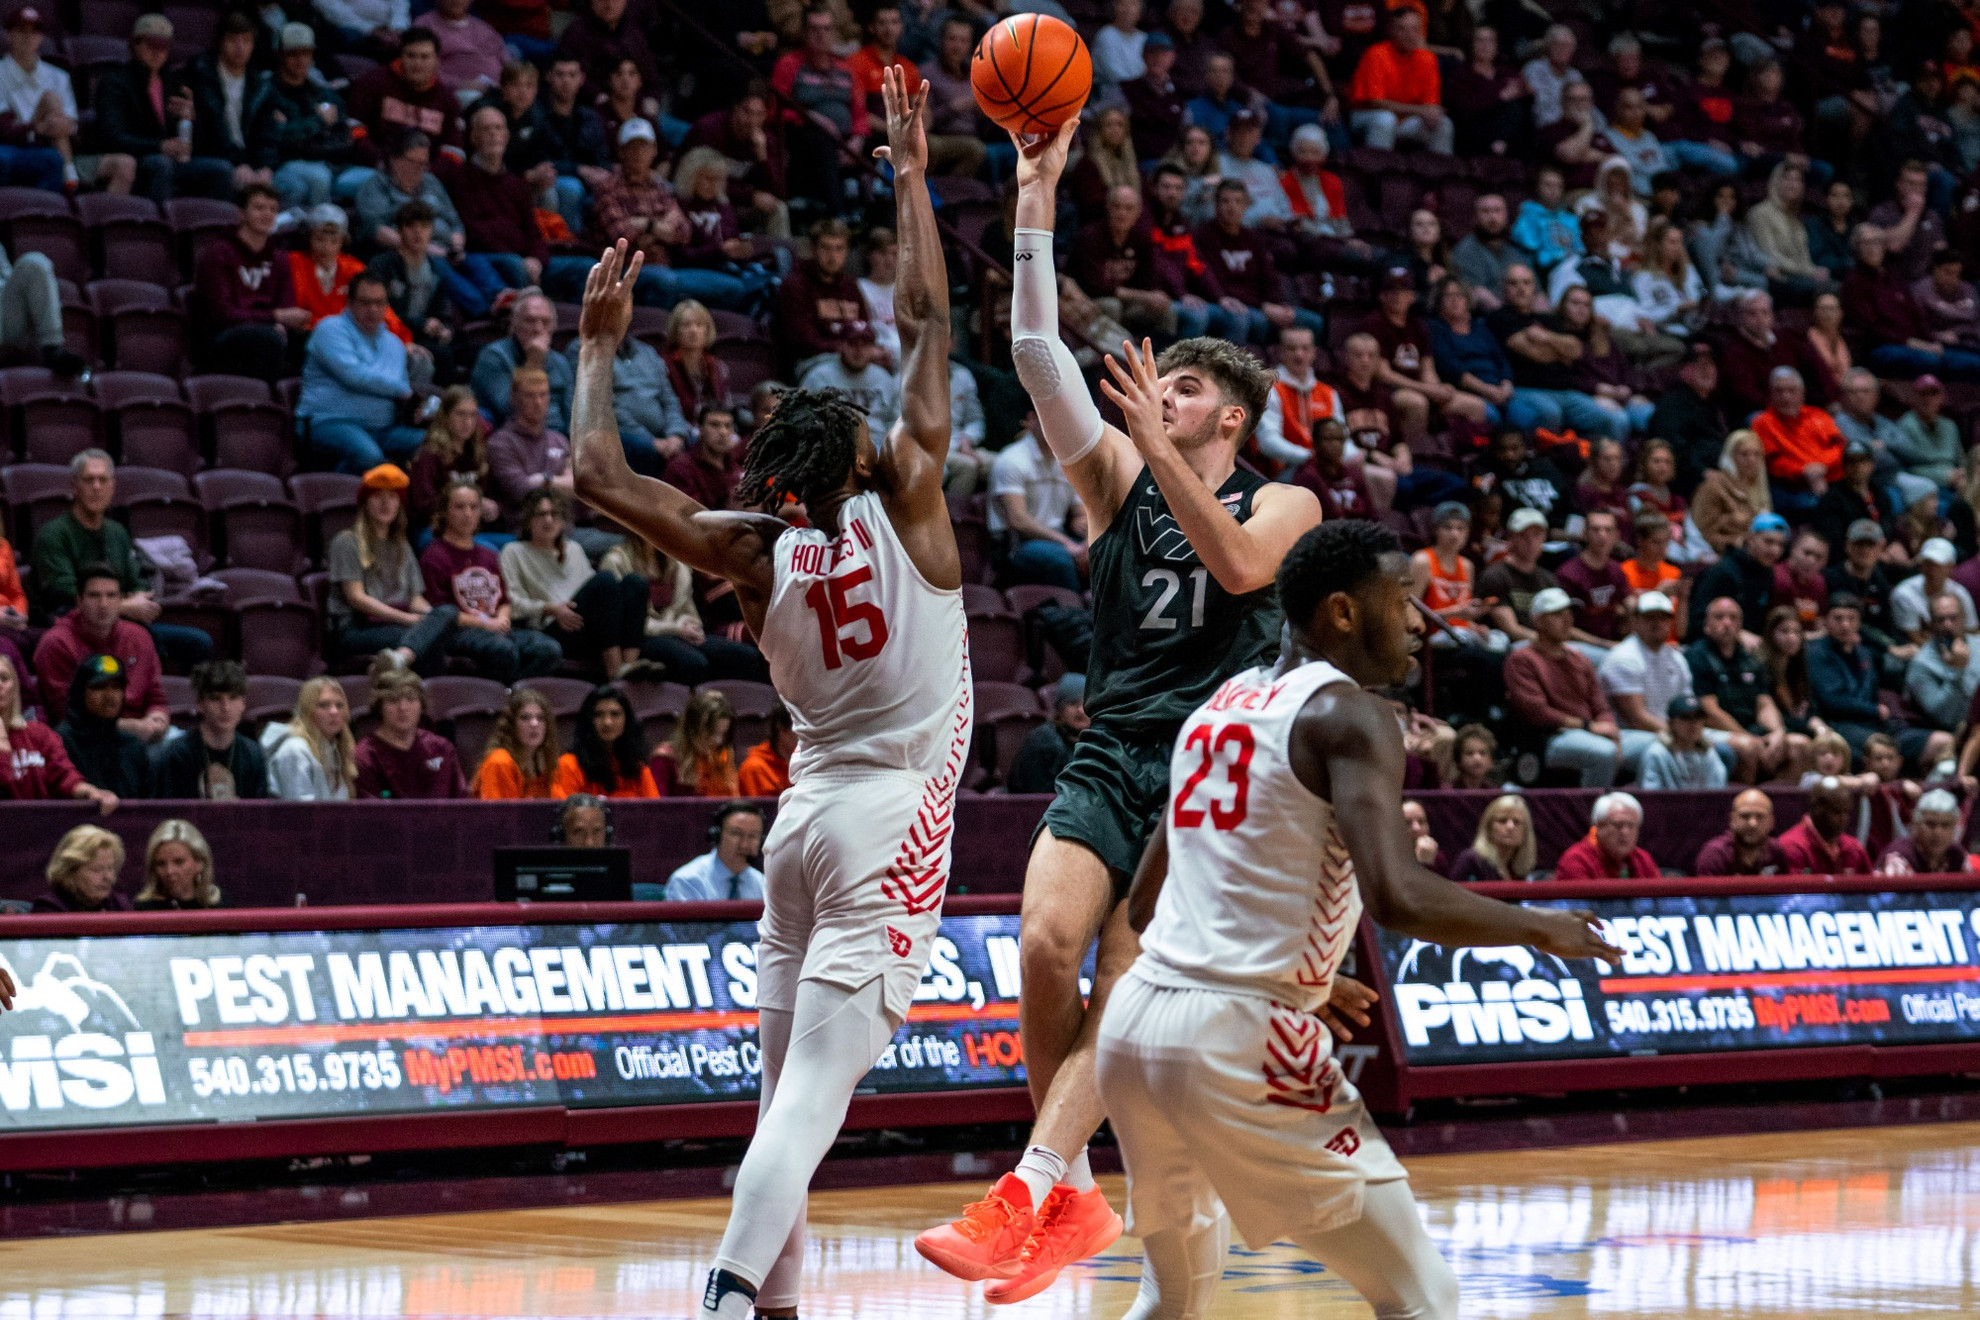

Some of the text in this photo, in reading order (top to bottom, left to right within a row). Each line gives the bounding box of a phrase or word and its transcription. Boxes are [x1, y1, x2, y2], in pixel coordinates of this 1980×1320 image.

[805, 565, 889, 670] 15
[1138, 567, 1207, 629] 21
[1173, 723, 1256, 831] 23
[1693, 910, 1969, 972] MANAGEMENT
[170, 953, 316, 1025] PEST
[326, 942, 714, 1020] MANAGEMENT
[1604, 995, 1755, 1034] 540.315.9735
[1753, 993, 1890, 1034] MyPMSI.com
[1901, 993, 1957, 1025] Official
[188, 1050, 402, 1097] 540.315.9735
[403, 1045, 597, 1095] MyPMSI.com
[615, 1044, 691, 1080] Official
[690, 1043, 742, 1076] Pest
[900, 1035, 924, 1069] of
[923, 1034, 960, 1068] the
